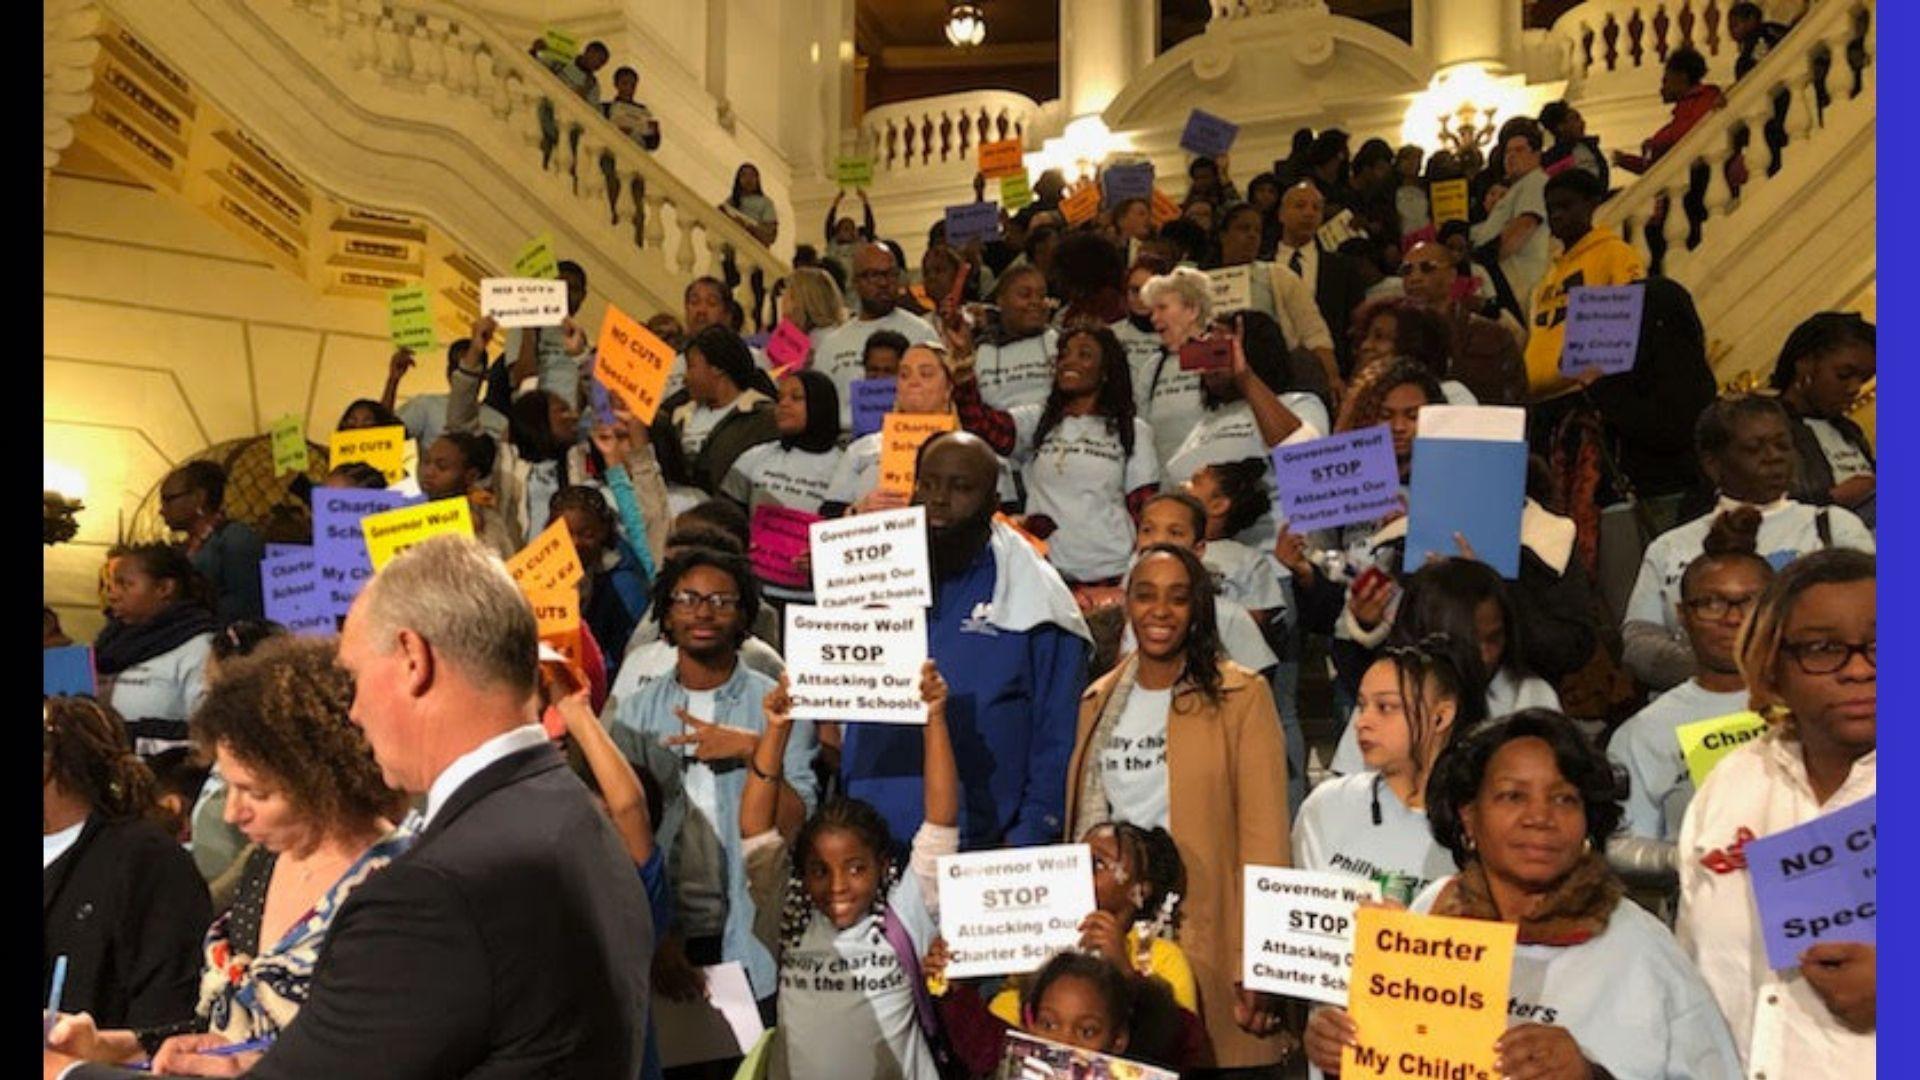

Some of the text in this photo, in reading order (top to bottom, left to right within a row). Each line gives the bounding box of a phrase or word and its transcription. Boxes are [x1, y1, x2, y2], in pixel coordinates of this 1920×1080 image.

[610, 325, 663, 371] NO CUTS
[599, 357, 654, 408] Special Ed
[359, 440, 393, 453] CUTS
[1281, 433, 1383, 463] Governor Wolf
[1310, 458, 1363, 482] STOP
[1293, 480, 1387, 506] Attacking Our
[427, 509, 460, 526] Wolf
[1288, 507, 1340, 521] Charter
[820, 517, 917, 543] Governor Wolf
[526, 538, 560, 571] CUTS
[843, 542, 893, 565] STOP
[271, 561, 315, 579] Charte
[322, 566, 346, 583] My
[827, 568, 916, 588] Attacking Our
[271, 582, 315, 600] School
[822, 586, 925, 608] Charter Schools
[535, 606, 568, 620] UTS
[794, 615, 915, 633] Governor Wolf
[820, 643, 884, 662] STOP
[796, 672, 911, 691] Attacking Our
[790, 694, 921, 710] Charter Schools
[1702, 724, 1768, 751] Chart
[1125, 756, 1152, 771] the
[949, 854, 1078, 879] Governor Wolf
[1328, 852, 1383, 882] Philly
[1779, 844, 1834, 877] NO
[983, 886, 1049, 909] STOP
[1256, 876, 1338, 899] Governor
[958, 921, 1044, 939] Attacking
[1287, 908, 1349, 934] STOP
[1783, 901, 1876, 939] Spec
[951, 948, 1016, 964] Charter
[1261, 938, 1341, 967] Attacking
[1376, 928, 1488, 963] Charter
[814, 974, 845, 992] the
[1252, 962, 1317, 985] Charter
[1369, 973, 1485, 1011] Schools
[1508, 996, 1558, 1025] ters
[1353, 1045, 1490, 1080] My Child's
